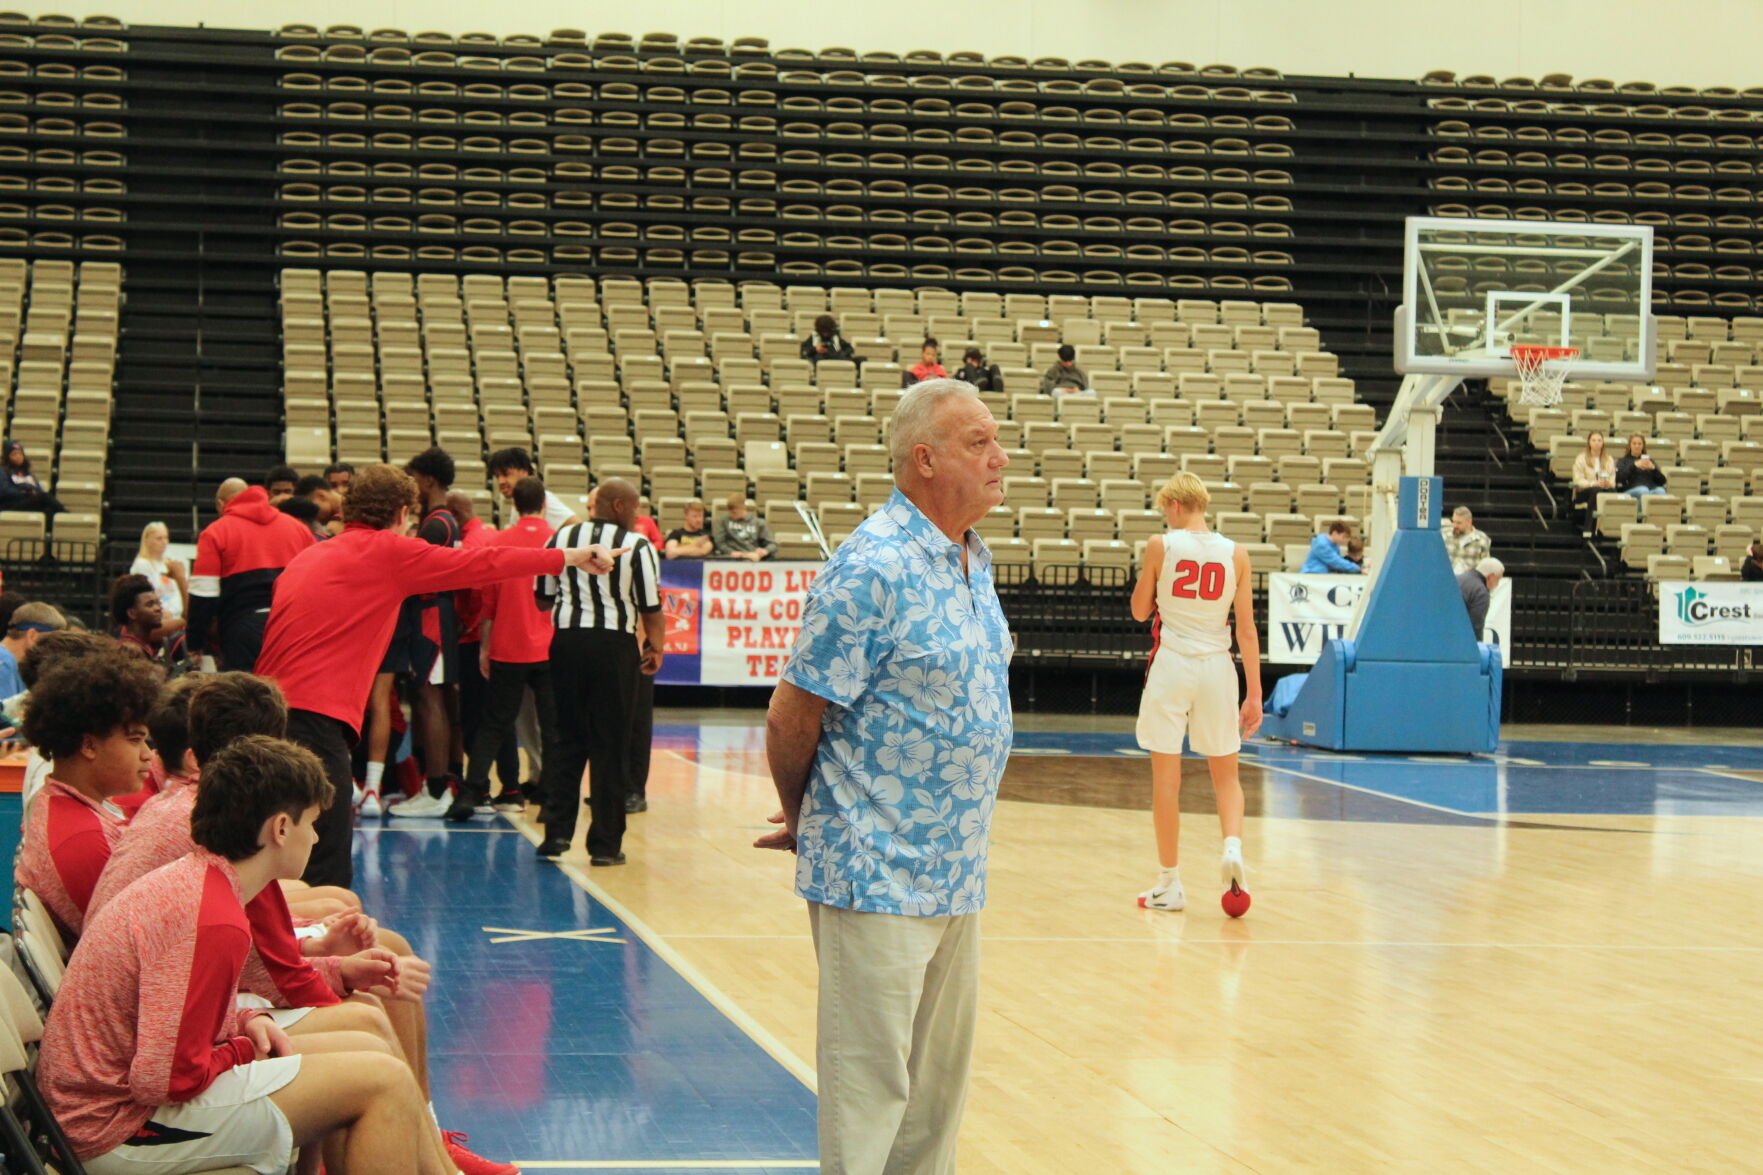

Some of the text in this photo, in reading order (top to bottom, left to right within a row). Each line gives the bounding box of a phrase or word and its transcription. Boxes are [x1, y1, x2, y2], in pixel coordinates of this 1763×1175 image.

[708, 570, 817, 593] GOOD LU
[1172, 559, 1226, 601] 20
[708, 598, 800, 621] ALL CO
[1690, 601, 1751, 621] Crest
[726, 626, 801, 649] PLAY
[746, 654, 790, 677] TE
